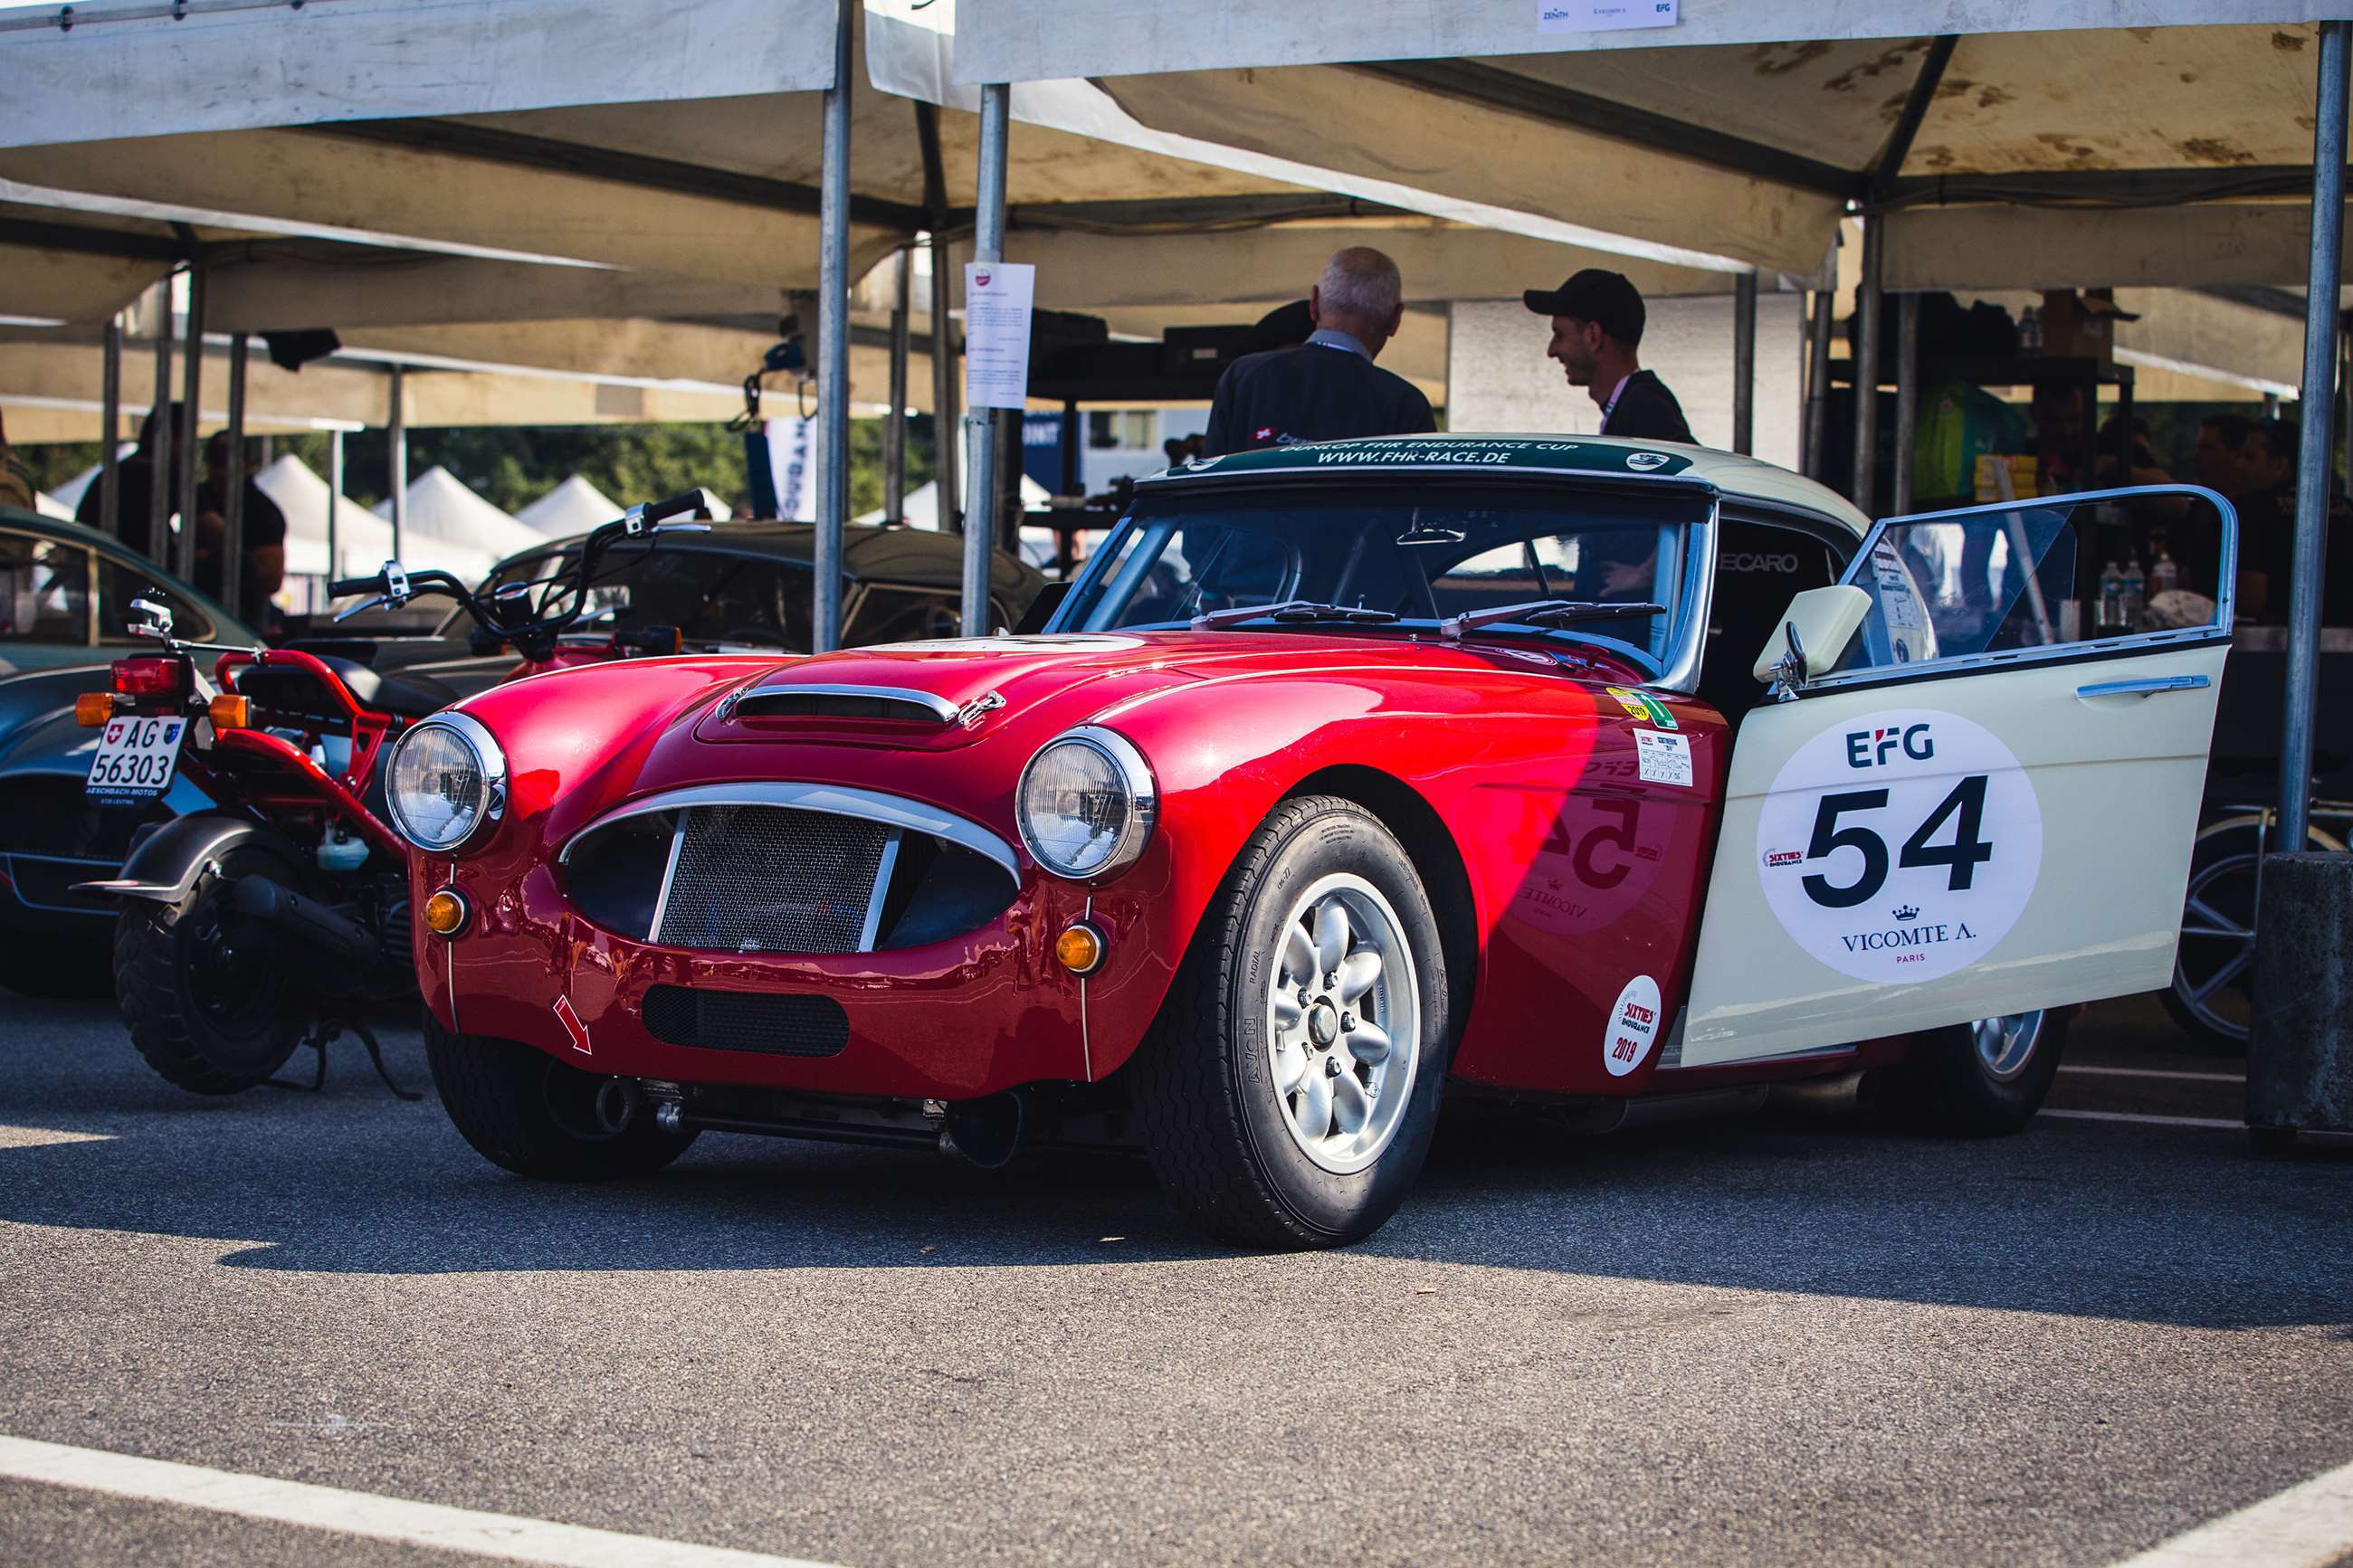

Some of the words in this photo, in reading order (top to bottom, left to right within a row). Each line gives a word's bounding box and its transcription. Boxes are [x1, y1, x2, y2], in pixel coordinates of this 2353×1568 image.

[1655, 4, 1671, 13] EFG
[1280, 442, 1361, 452] DUNLOP
[1364, 441, 1404, 449] FHR
[1404, 441, 1533, 450] ENDURANCE
[1536, 442, 1579, 451] CUP
[1318, 451, 1511, 464] WWW.FHR-RACE.DE
[1718, 553, 1799, 574] ECARO
[124, 720, 160, 748] AG
[1846, 723, 1934, 768] EFG
[91, 754, 169, 785] 56303
[1802, 774, 1993, 908] 54
[1842, 923, 1948, 954] VICOMTE
[1249, 950, 1261, 984] RADIAL
[1896, 953, 1925, 964] PARIS
[1621, 1017, 1651, 1034] ENDURANCE
[1612, 1036, 1638, 1063] 2019
